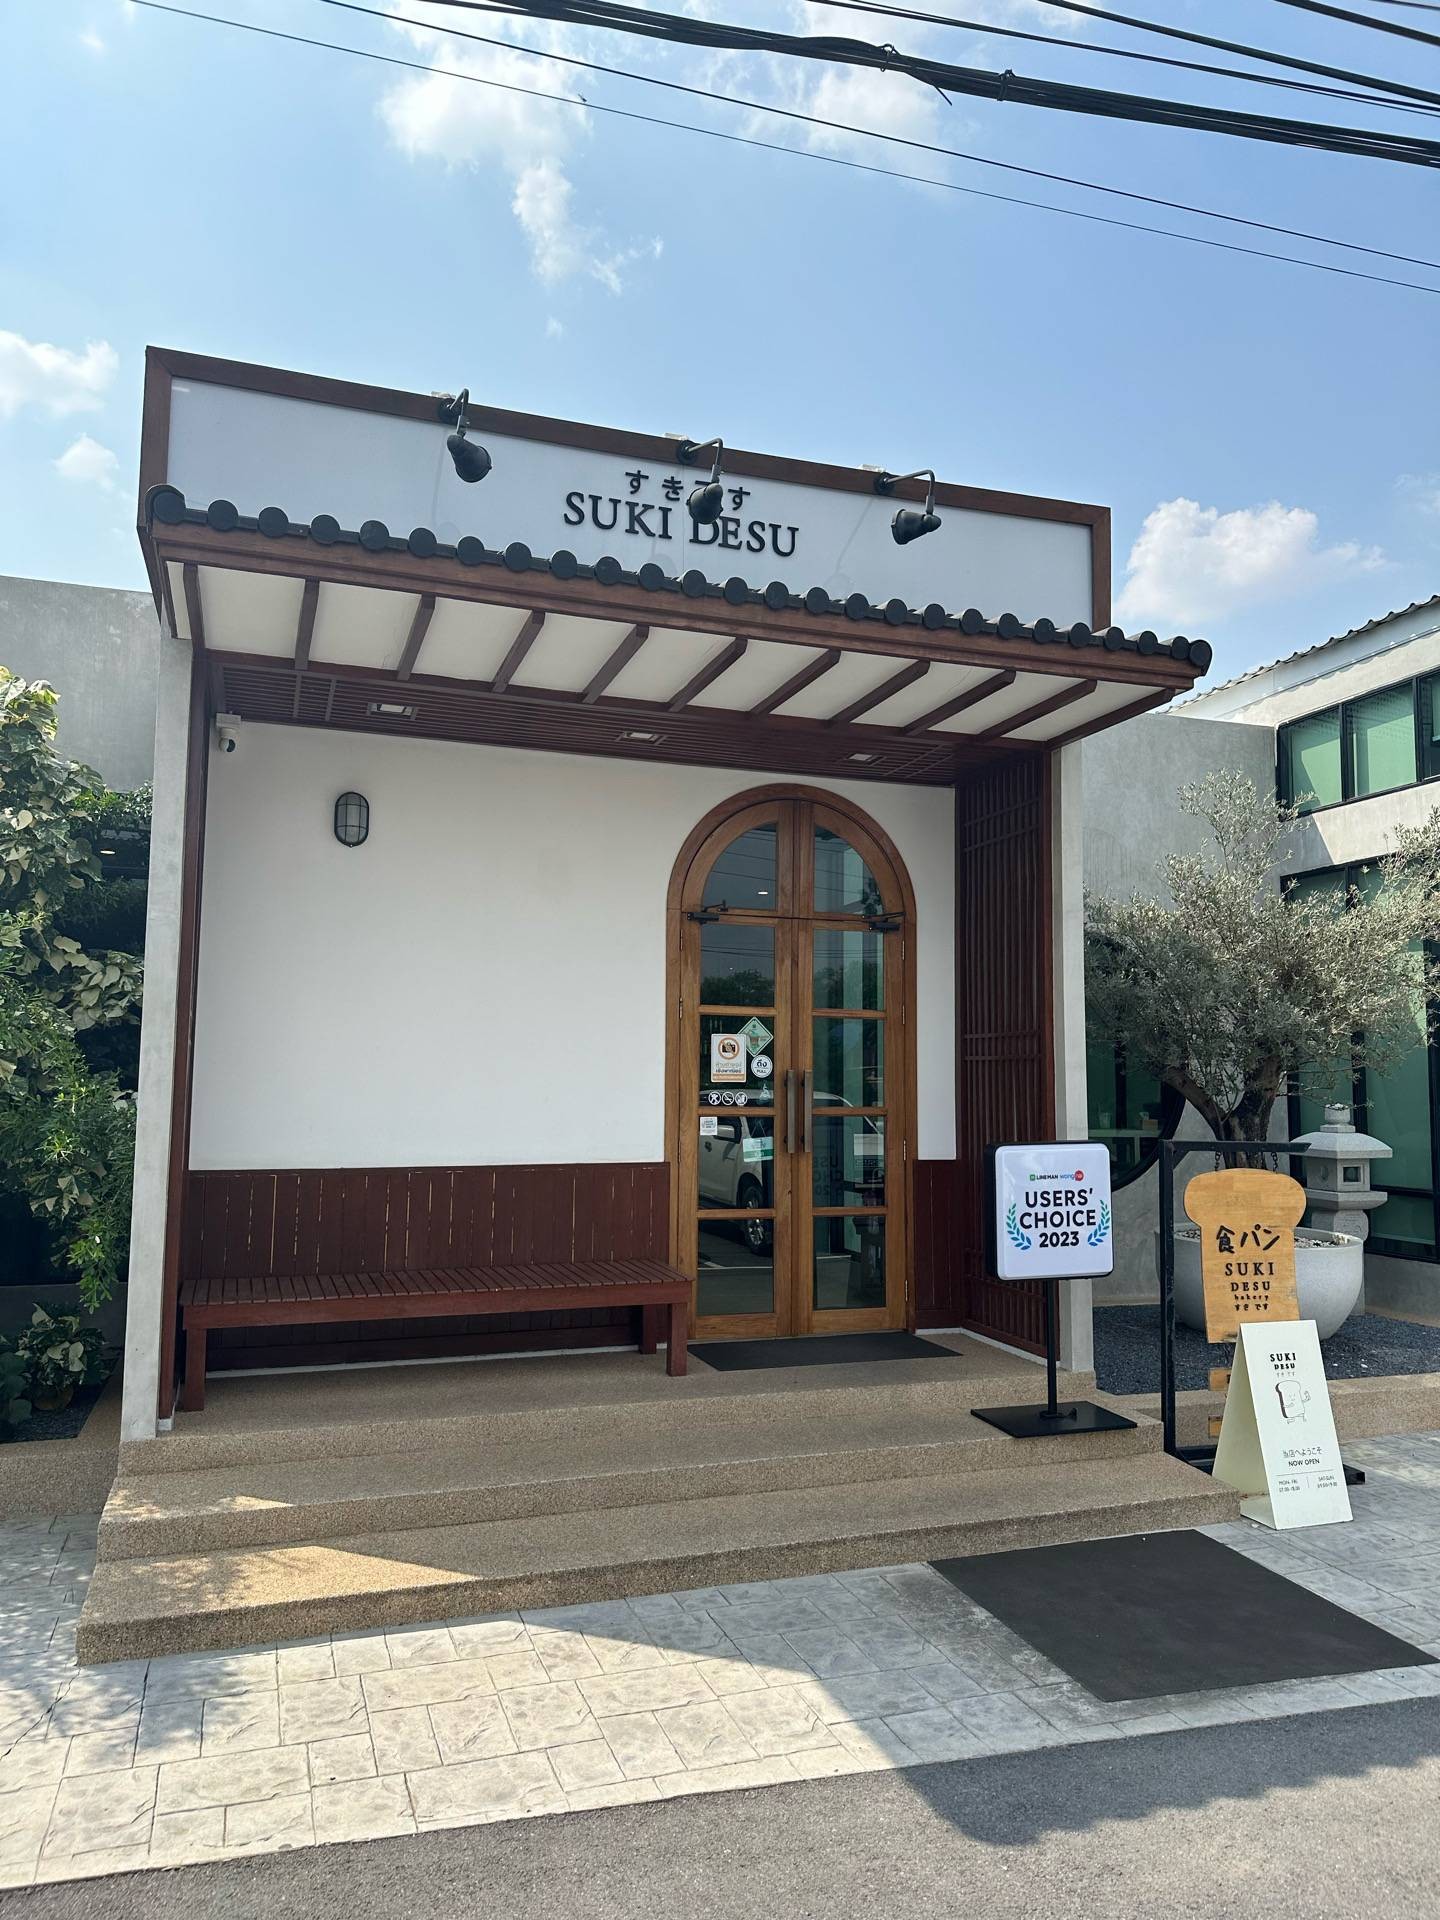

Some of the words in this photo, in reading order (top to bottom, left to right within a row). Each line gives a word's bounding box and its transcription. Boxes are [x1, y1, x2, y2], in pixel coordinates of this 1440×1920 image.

[625, 470, 750, 511] すきす
[563, 491, 673, 540] SUKI
[689, 514, 799, 558] DESU
[756, 1059, 768, 1068] ดึง
[1025, 1188, 1093, 1208] USERS'
[1020, 1209, 1096, 1229] CHOICE
[1039, 1231, 1080, 1248] 2023
[1216, 1224, 1280, 1254] 食パン
[1225, 1262, 1275, 1276] SUKI
[1231, 1281, 1271, 1292] DESU
[1234, 1293, 1269, 1301] bakery
[1269, 1352, 1296, 1362] SUKI
[1274, 1362, 1295, 1370] DESU
